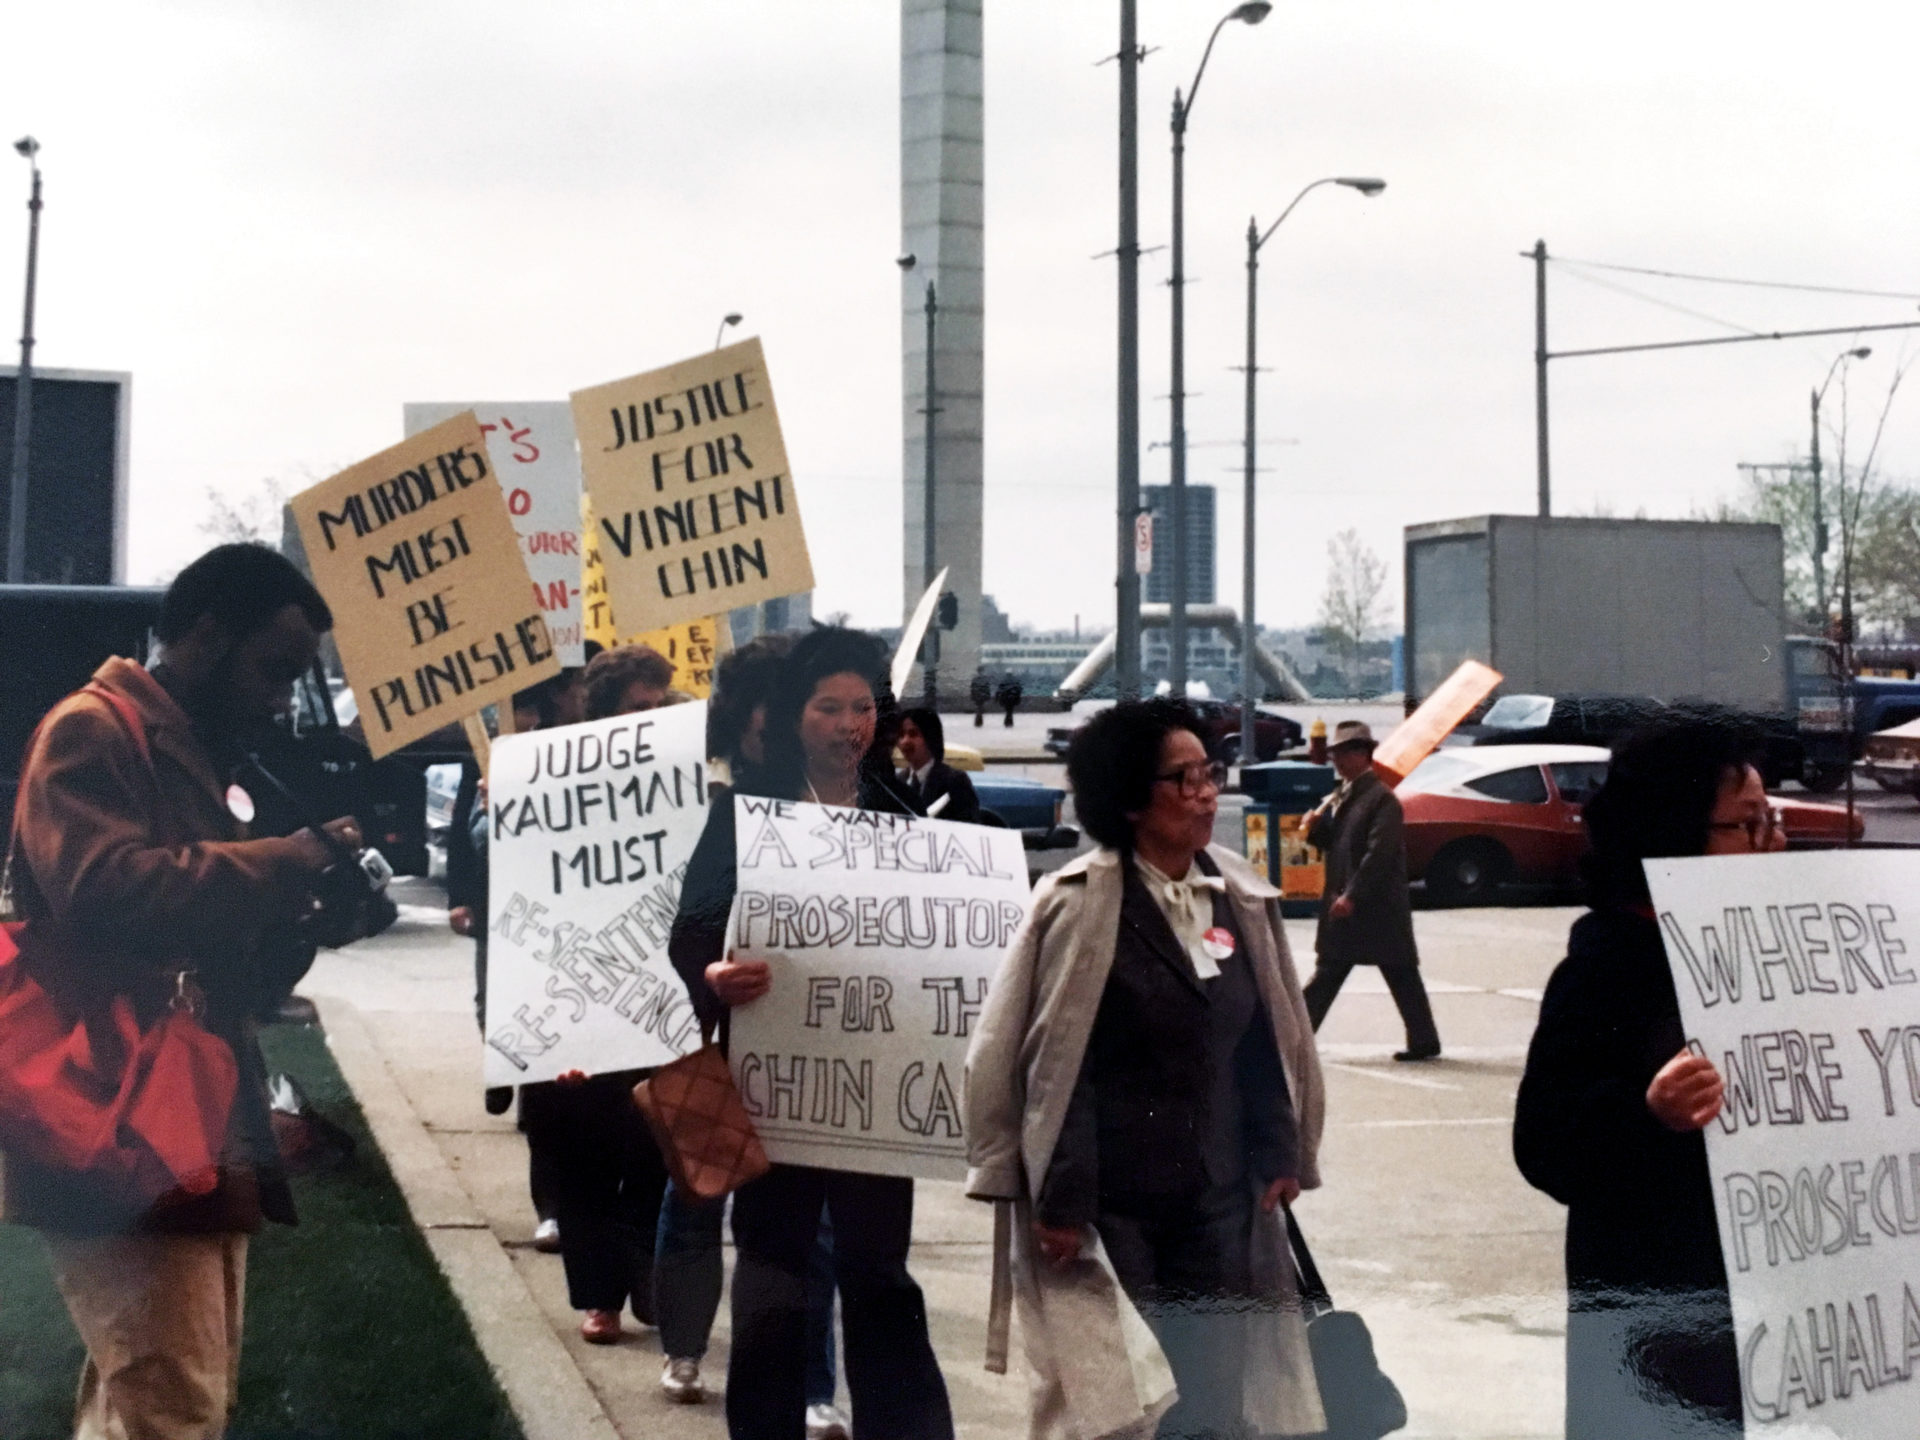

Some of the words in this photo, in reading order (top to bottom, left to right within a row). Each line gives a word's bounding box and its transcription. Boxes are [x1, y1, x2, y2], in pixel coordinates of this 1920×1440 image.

[603, 368, 763, 452] JUSTICE
[652, 432, 753, 491] FOR
[317, 442, 487, 551] MURDERS
[601, 472, 786, 558] VINCENT
[364, 514, 471, 599] MUST
[657, 538, 768, 598] CHIN
[406, 586, 465, 648] BE
[528, 721, 654, 784] JUDGE
[495, 762, 704, 841] KAUFMAN
[742, 798, 797, 820] WE
[822, 806, 919, 831] WANT
[552, 829, 667, 894] MUST
[741, 816, 797, 868] A
[809, 821, 1013, 880] SPECIAL
[737, 890, 1024, 949] PROSECUTOR
[1660, 902, 1918, 1008] WHERE
[805, 976, 895, 1032] FOR
[741, 1052, 873, 1130] CHIN
[1686, 1029, 1849, 1135] WERE
